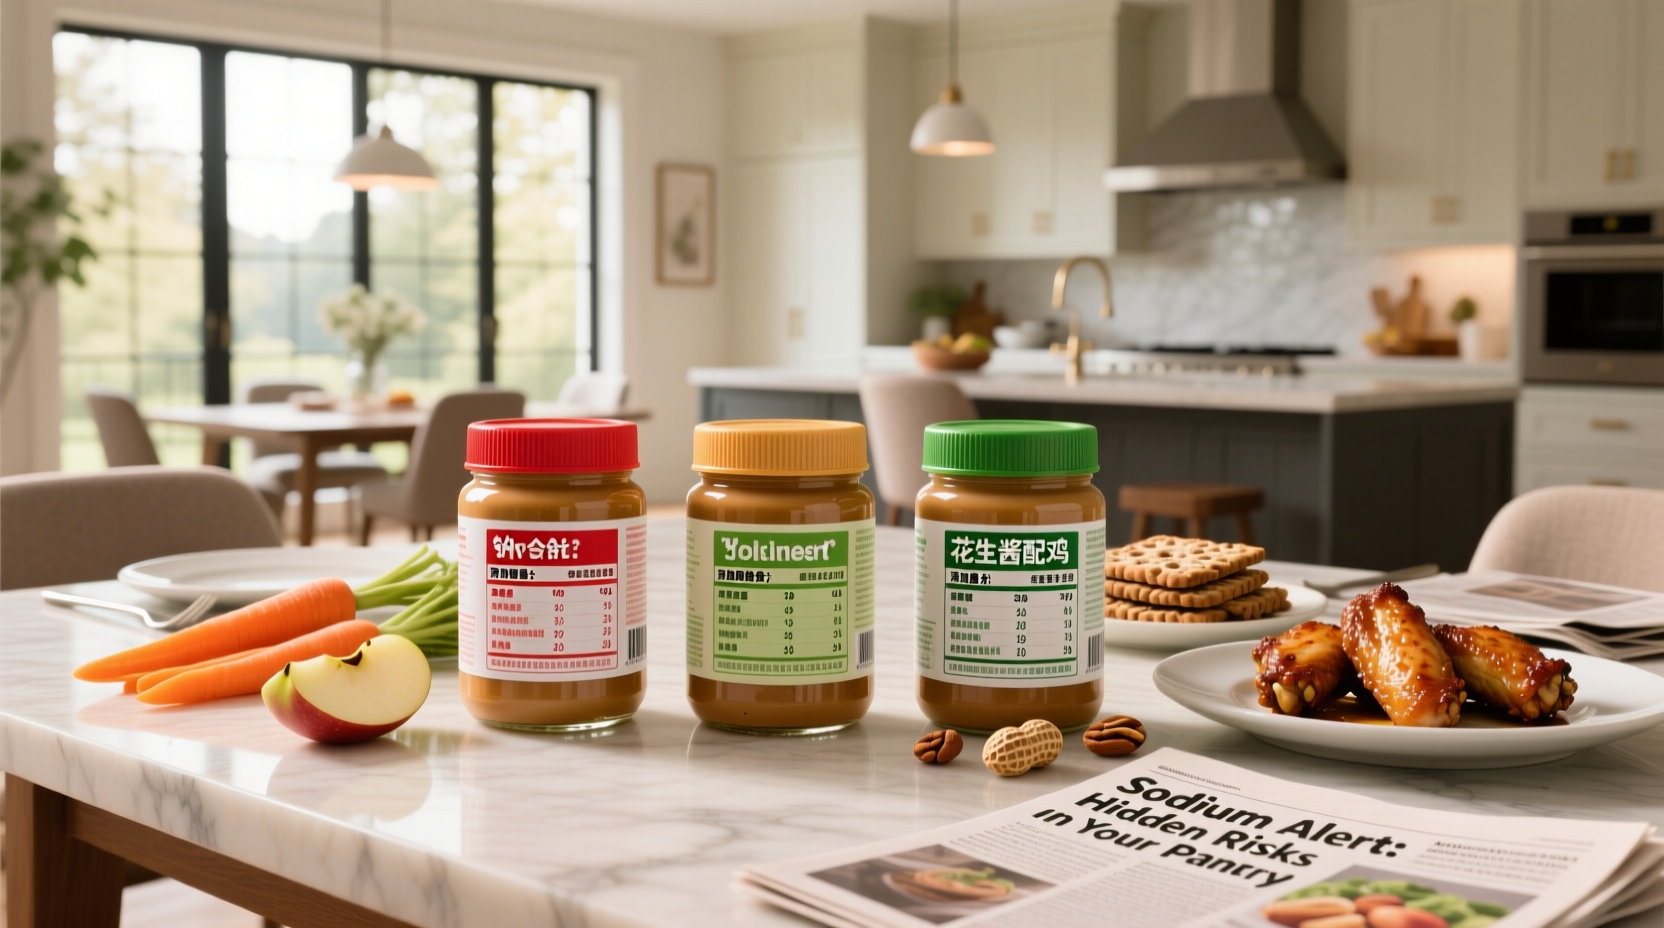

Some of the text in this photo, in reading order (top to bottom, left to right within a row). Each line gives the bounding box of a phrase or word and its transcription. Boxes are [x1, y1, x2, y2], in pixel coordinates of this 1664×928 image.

[950, 536, 1069, 566] 花生酱配鸡
[1074, 792, 1318, 867] Hidden Risks
[1077, 817, 1161, 851] Your
[1160, 843, 1294, 888] Pantry
[1117, 776, 1273, 830] Sodium
[1276, 819, 1407, 858] Alert:
